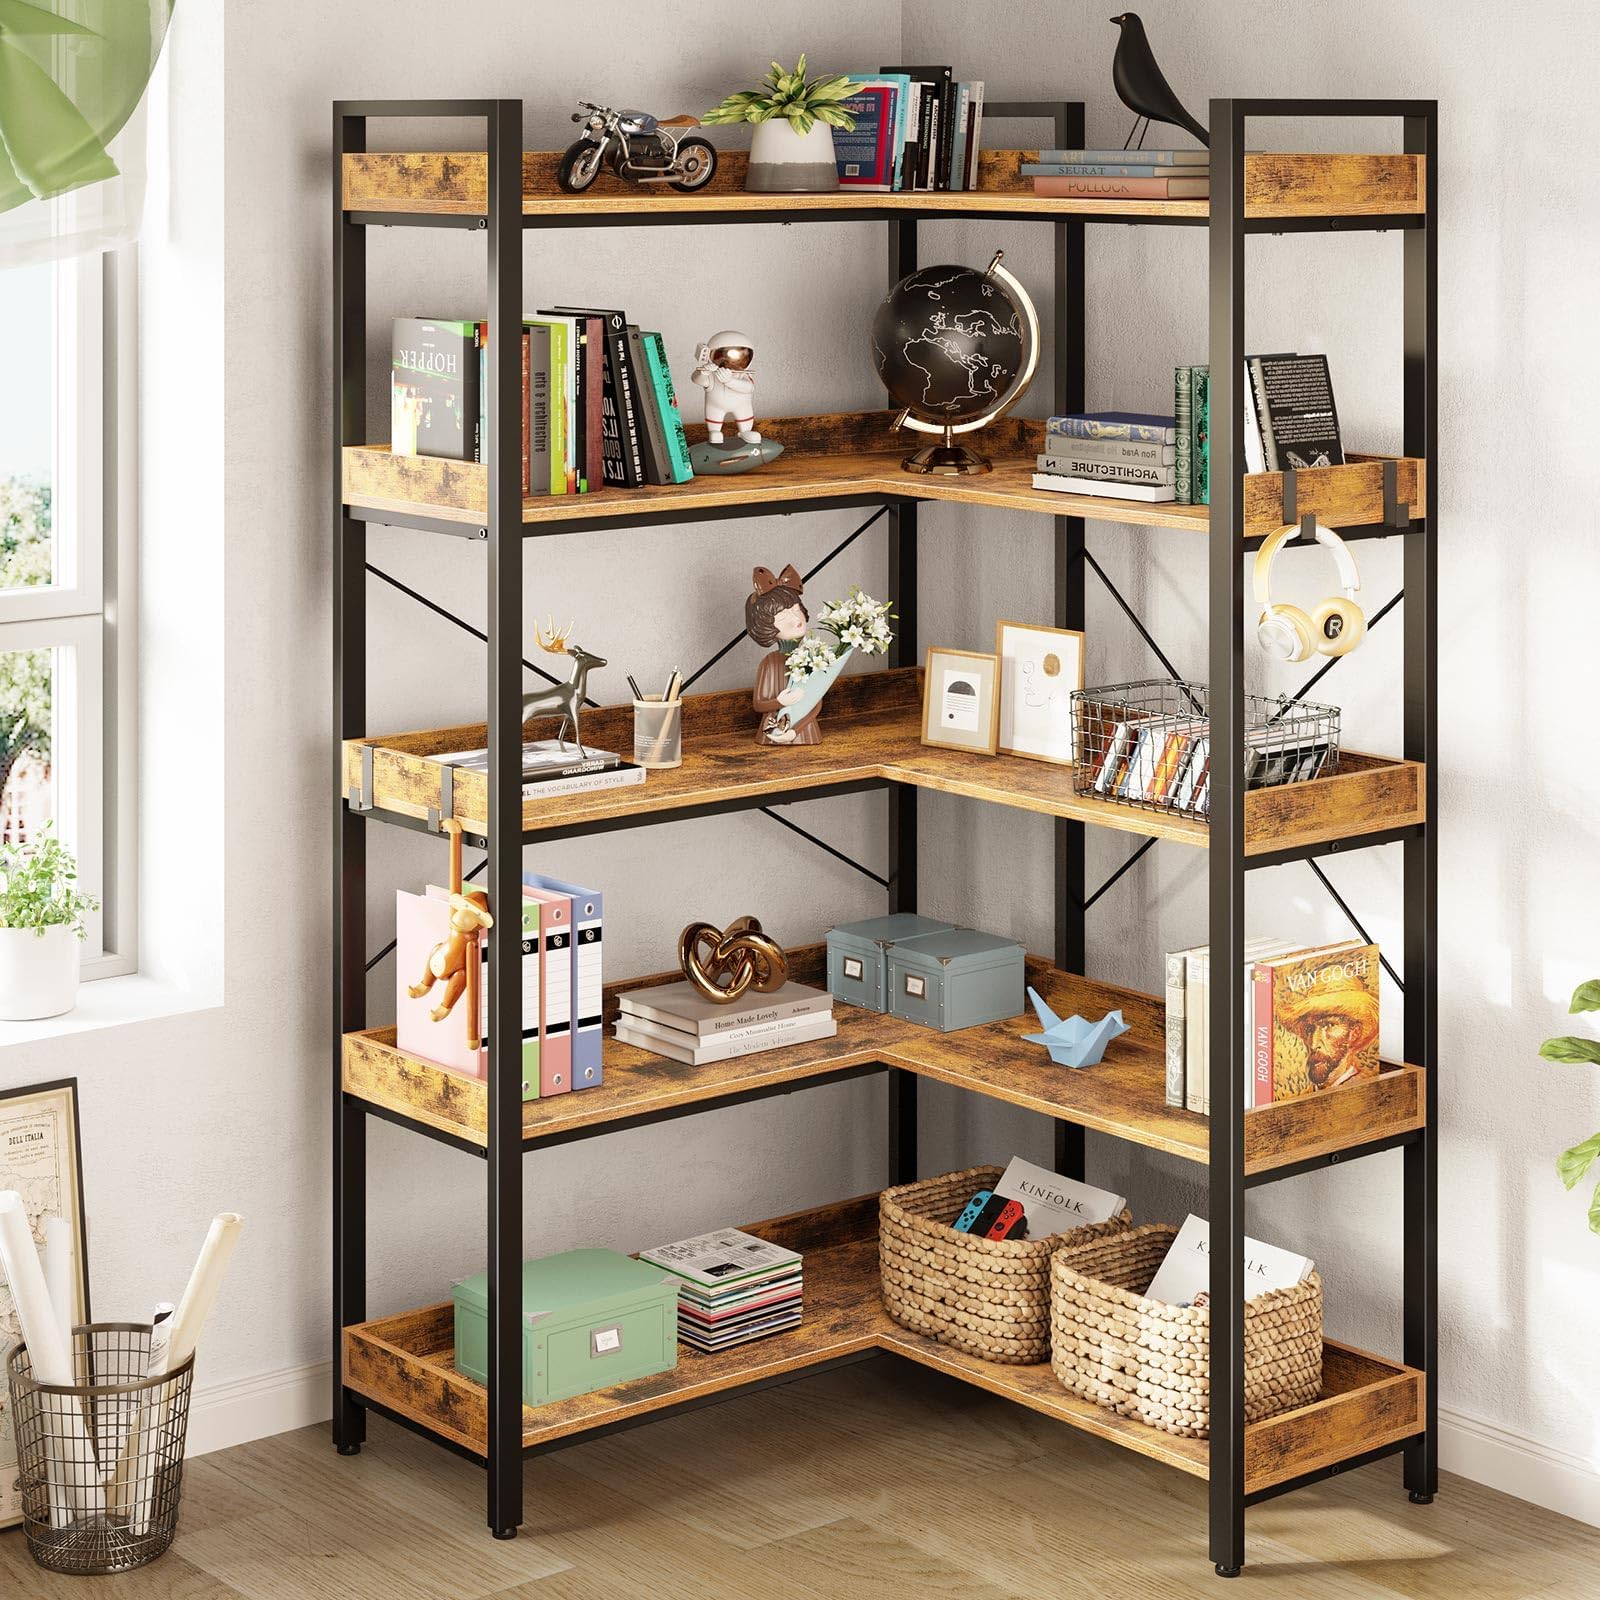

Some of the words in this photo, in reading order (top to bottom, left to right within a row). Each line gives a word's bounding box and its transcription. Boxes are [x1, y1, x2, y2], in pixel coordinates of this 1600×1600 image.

[1060, 152, 1086, 163] ART
[1058, 166, 1106, 175] SEURAT
[1068, 183, 1129, 193] POLLOCK
[400, 349, 457, 373] HOPPER
[535, 371, 546, 388] arts
[535, 402, 547, 453] architecture
[602, 440, 621, 459] GOO
[608, 460, 625, 480] IT'S
[1329, 619, 1342, 636] R
[532, 787, 545, 795] THE
[547, 781, 593, 793] VOCABULARY
[604, 776, 625, 785] STYLE
[1287, 970, 1317, 992] VAN
[1320, 959, 1368, 981] GOGH
[715, 1020, 735, 1030] Home
[737, 1016, 755, 1025] Made
[757, 1010, 778, 1020] Lovely
[743, 1041, 769, 1052] Modern
[1258, 1025, 1269, 1050] VAN
[1257, 1050, 1269, 1083] GOGH
[1019, 1180, 1084, 1213] KINFOLK
